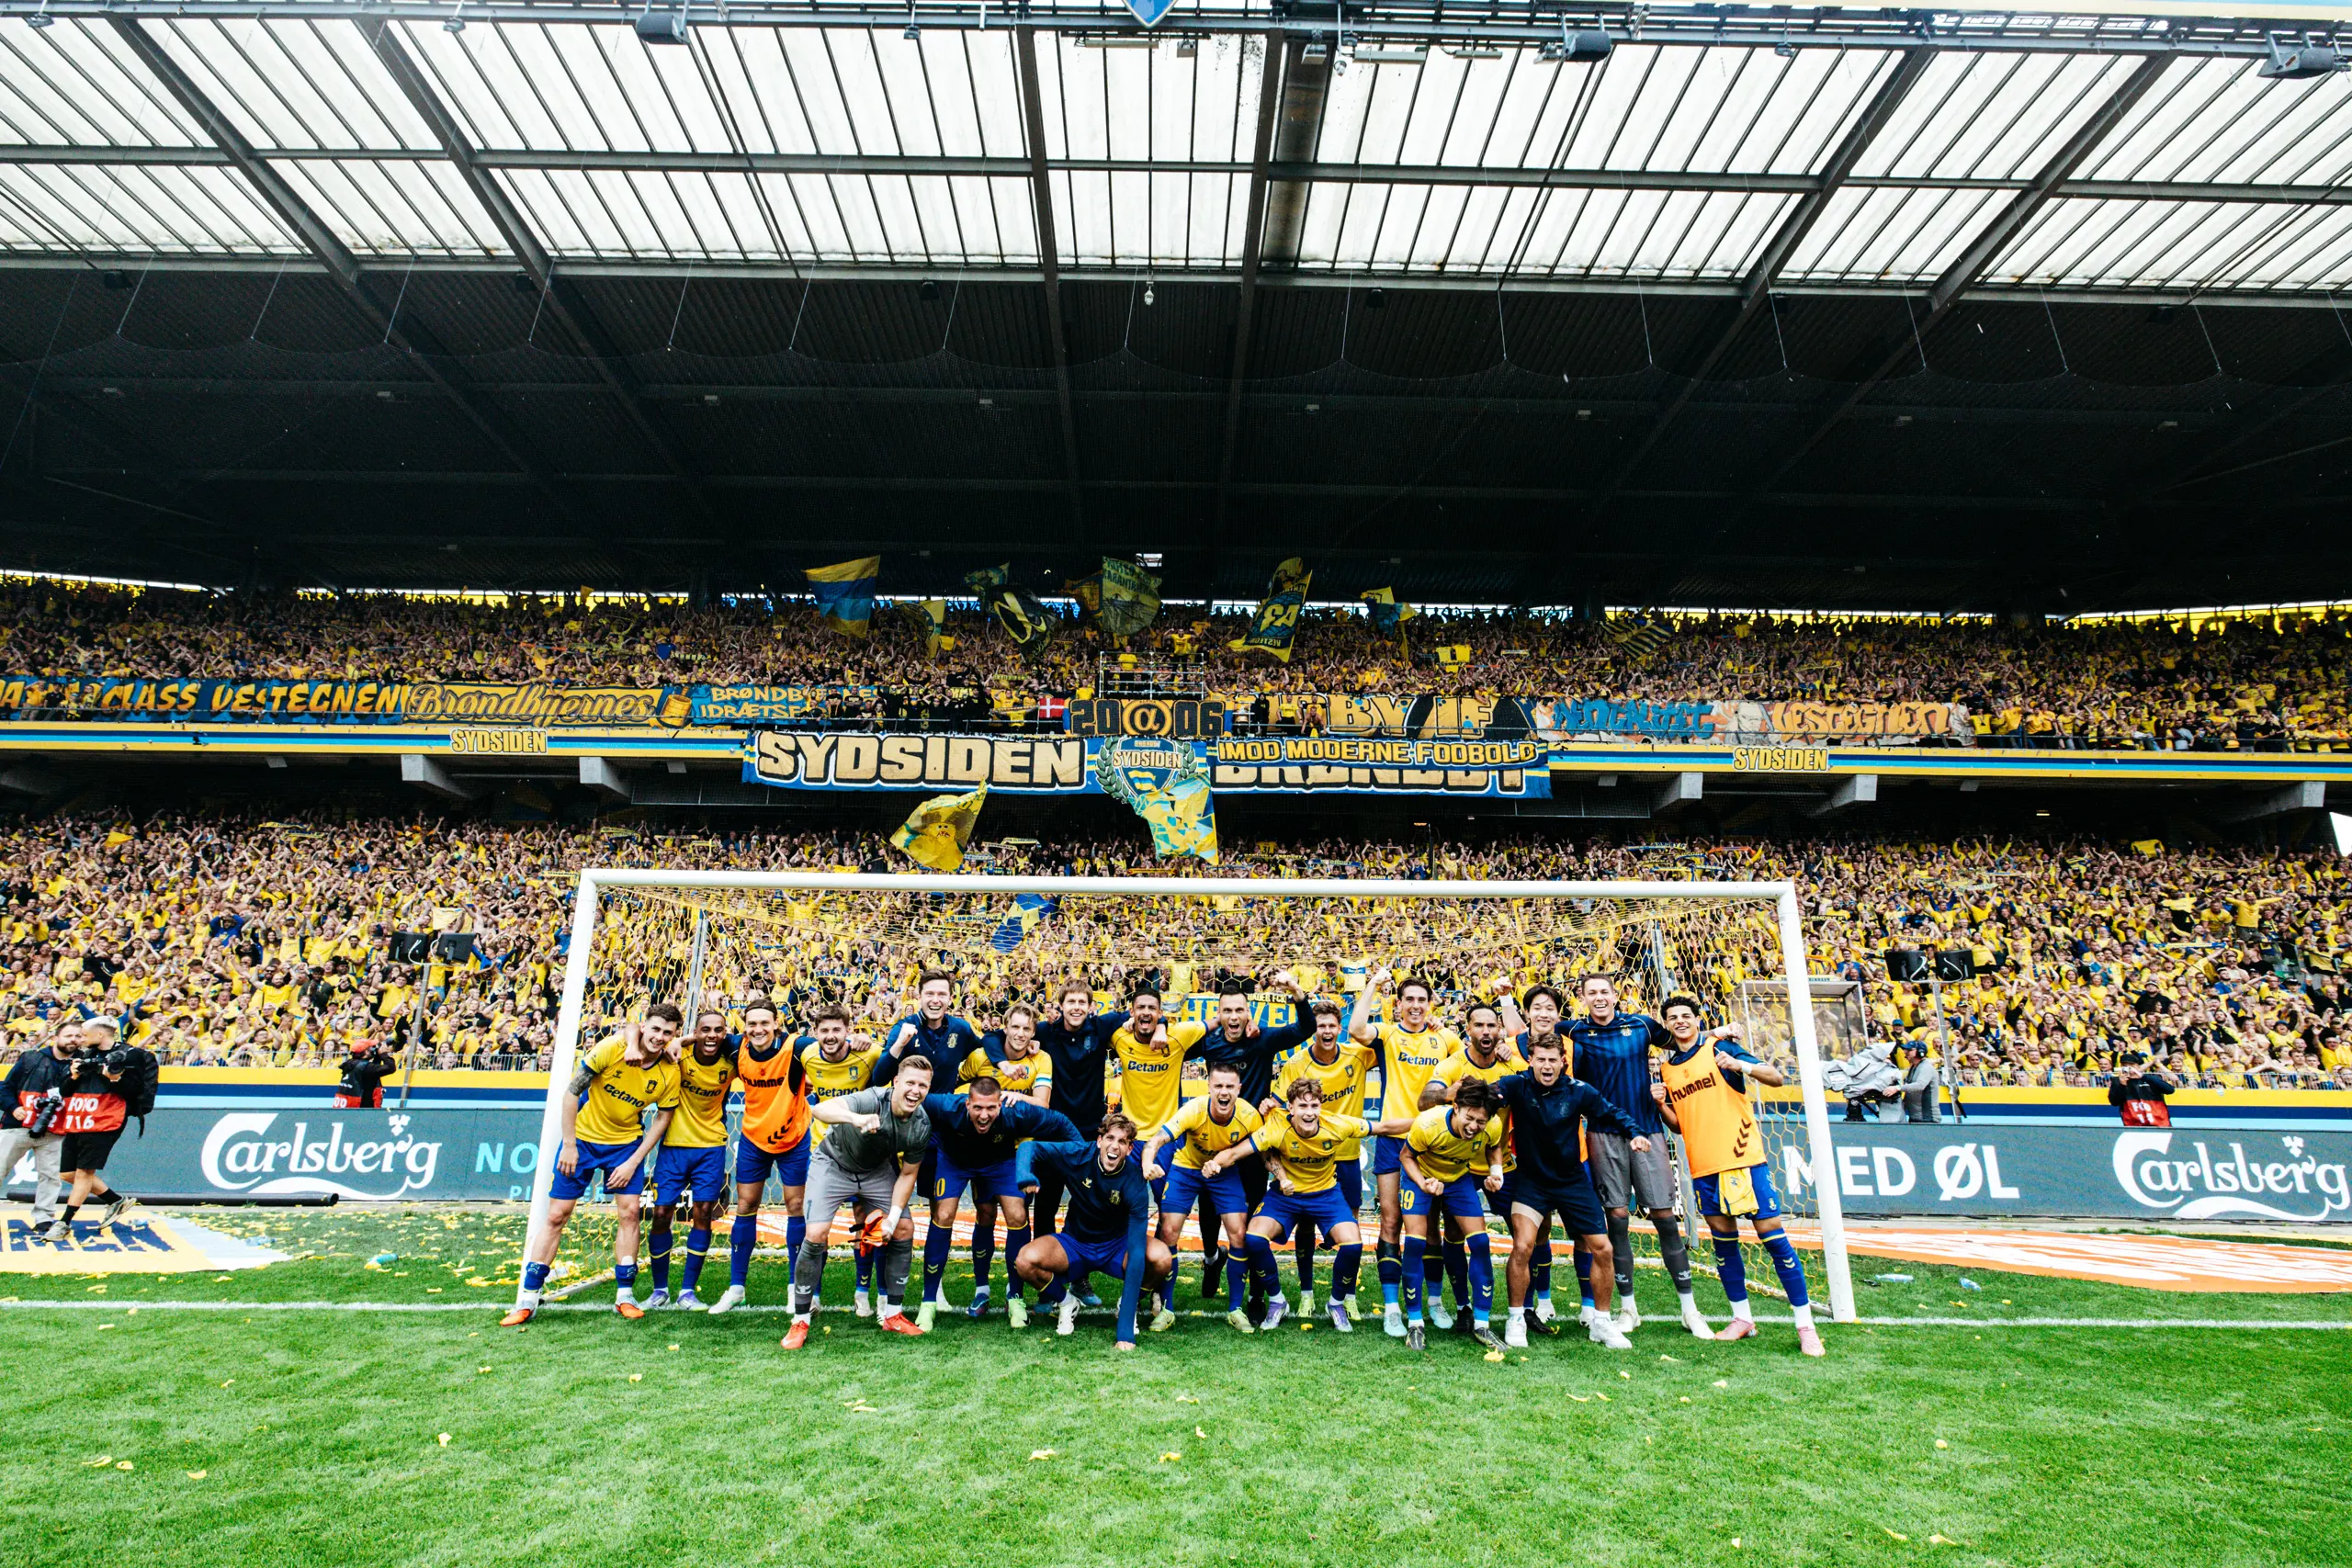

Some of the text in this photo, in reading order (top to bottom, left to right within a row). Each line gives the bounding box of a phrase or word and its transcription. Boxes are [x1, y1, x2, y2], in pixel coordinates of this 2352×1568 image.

[1070, 699, 1121, 735] 20
[1173, 701, 1225, 735] 06
[451, 729, 547, 753] SYDSIDEN
[1218, 739, 1537, 764] IMOD MODERNE FODBOLD
[757, 731, 1083, 784] SYDSIDEN
[1113, 750, 1183, 769] SYDSIDEN
[1734, 748, 1828, 771] SYDSIDEN
[1127, 1060, 1169, 1071] Betano
[1397, 1051, 1439, 1066] Betano
[680, 1078, 722, 1098] Betano
[741, 1073, 786, 1089] humme
[1672, 1072, 1716, 1102] hummel
[604, 1083, 644, 1108] Betano
[201, 1113, 442, 1190] Carlsberg
[1933, 1143, 2020, 1201] ØL
[2112, 1132, 2350, 1210] Carlsberg
